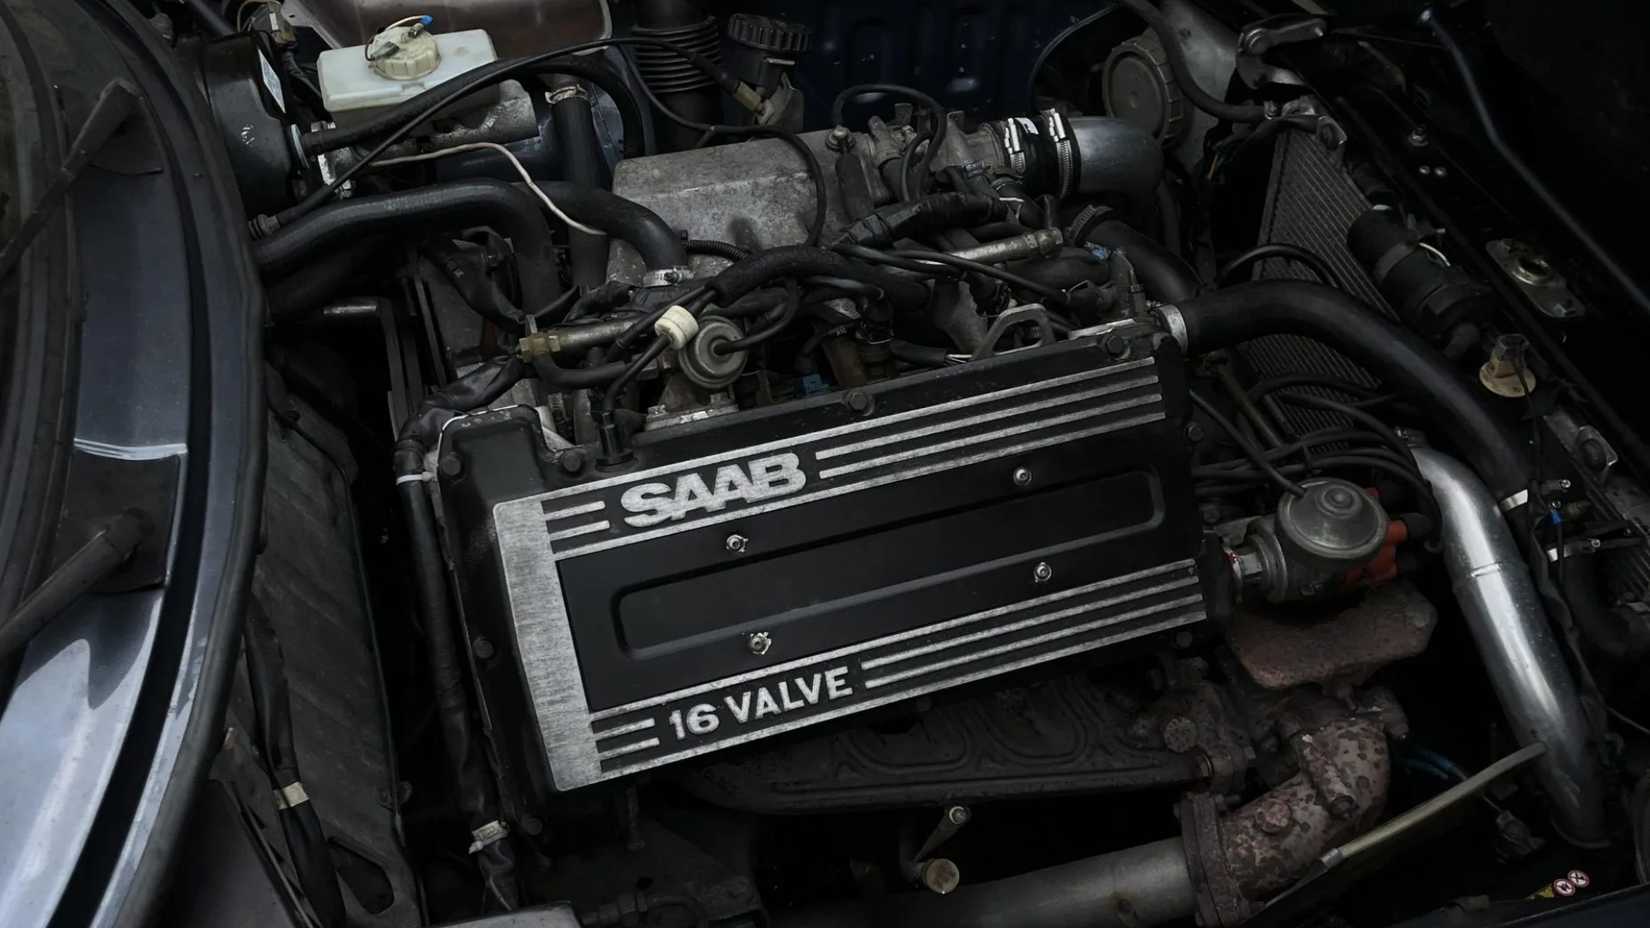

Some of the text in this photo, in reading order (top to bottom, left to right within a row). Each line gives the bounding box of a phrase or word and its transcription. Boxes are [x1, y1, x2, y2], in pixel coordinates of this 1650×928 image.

[621, 452, 807, 528] SAAB
[669, 665, 854, 740] 16 VALVE
